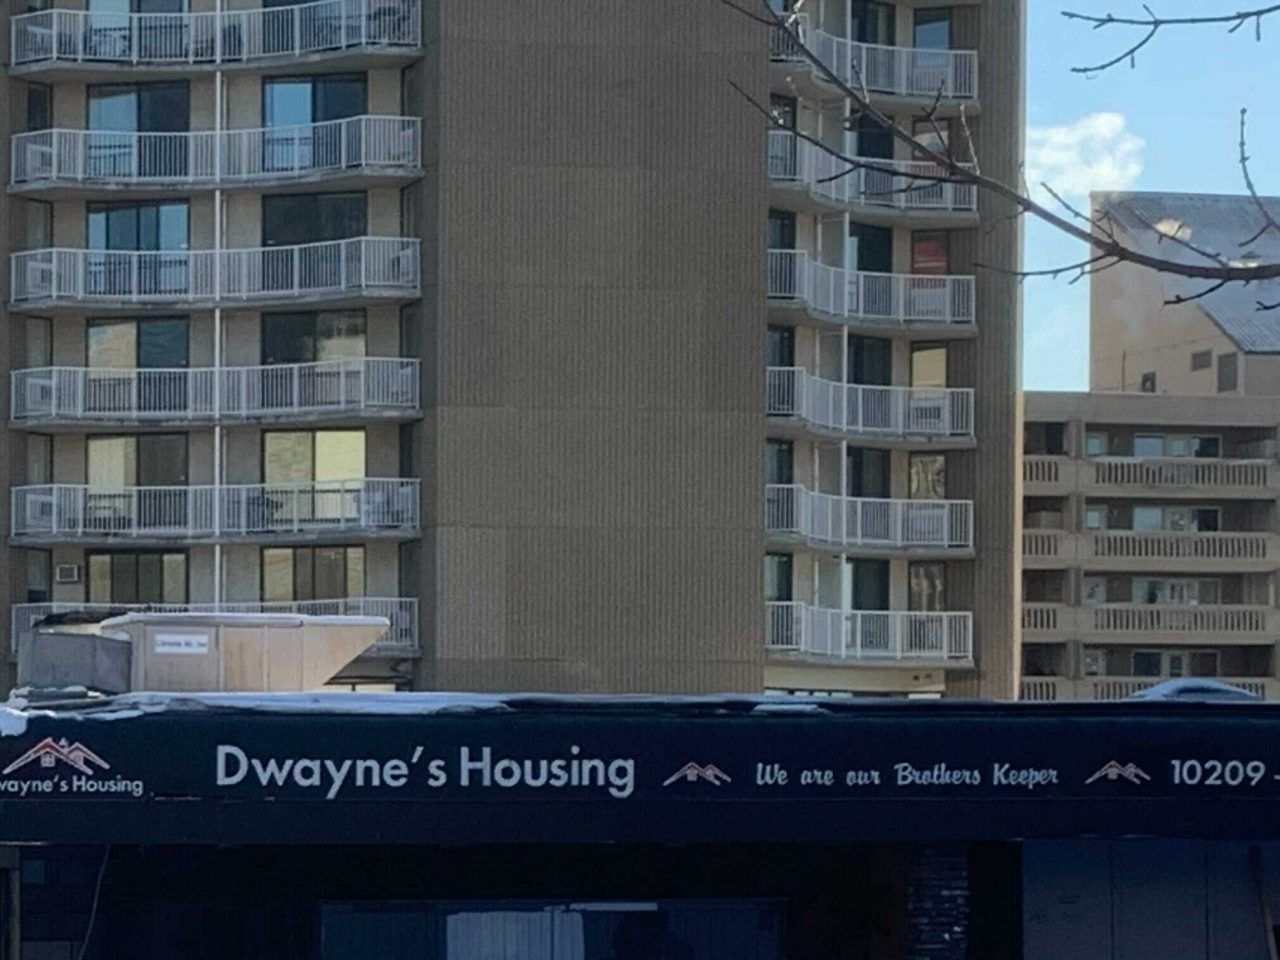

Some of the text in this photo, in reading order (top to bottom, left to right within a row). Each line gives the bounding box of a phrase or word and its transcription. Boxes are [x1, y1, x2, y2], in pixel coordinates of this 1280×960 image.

[216, 745, 635, 799] Dwayne's Housing
[756, 763, 1059, 789] We are our Brothers Keeper
[1171, 760, 1266, 786] 10209
[72, 774, 143, 797] Housing
